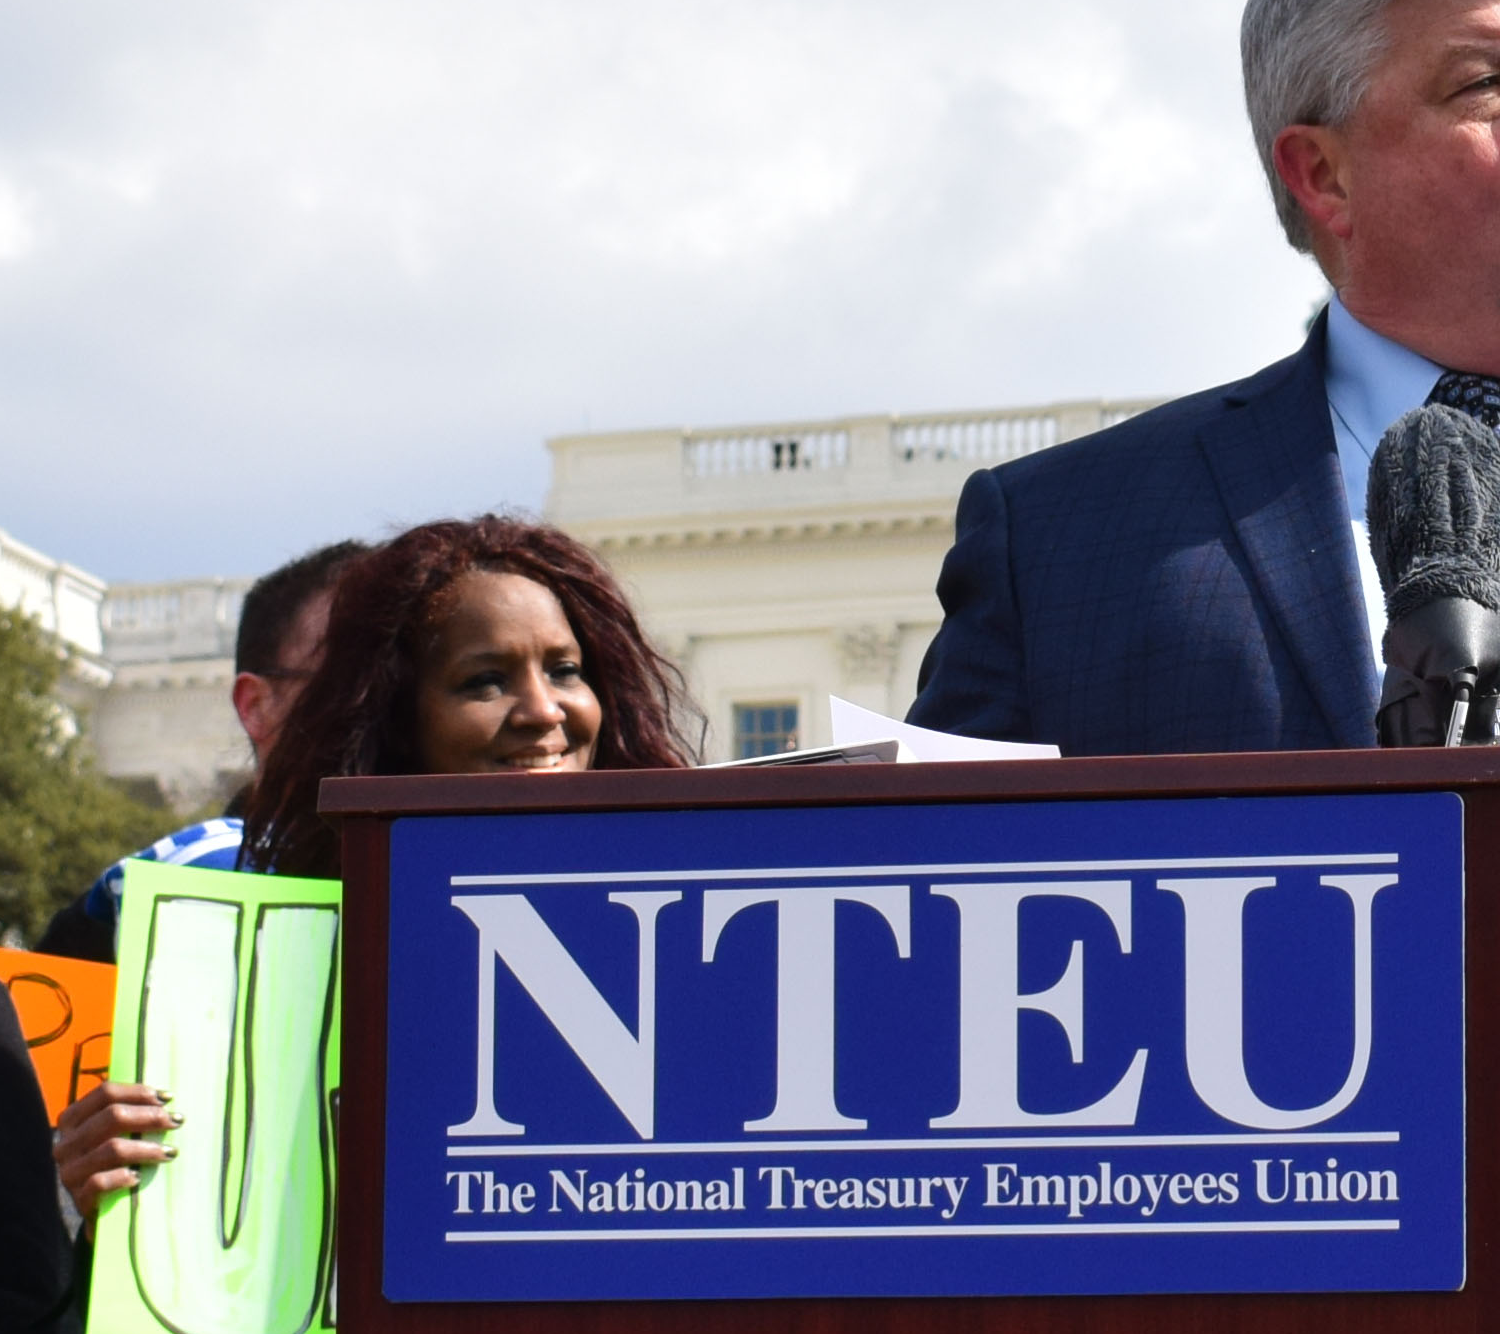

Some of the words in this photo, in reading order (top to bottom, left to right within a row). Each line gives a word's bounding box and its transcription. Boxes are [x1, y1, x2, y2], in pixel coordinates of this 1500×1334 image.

[446, 872, 1399, 1140] NTEU
[446, 1170, 536, 1214] The
[549, 1167, 746, 1213] National
[758, 1165, 970, 1220] Treasury
[982, 1161, 1240, 1219] Employees
[1252, 1156, 1400, 1204] Union
